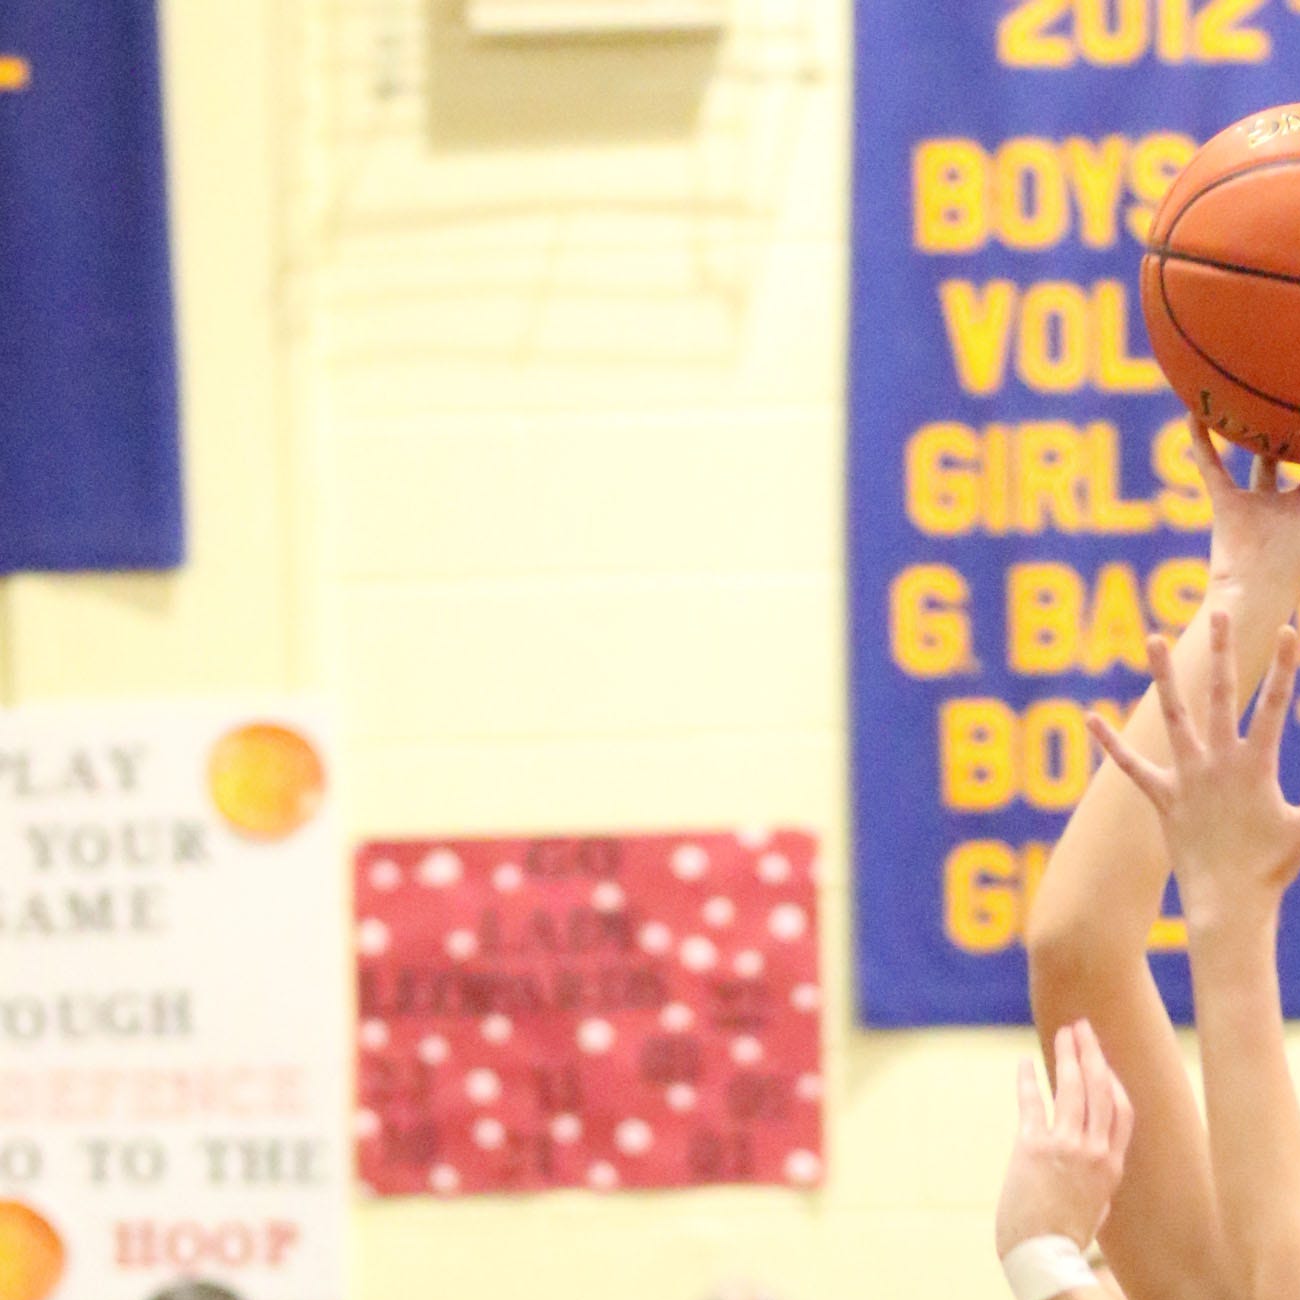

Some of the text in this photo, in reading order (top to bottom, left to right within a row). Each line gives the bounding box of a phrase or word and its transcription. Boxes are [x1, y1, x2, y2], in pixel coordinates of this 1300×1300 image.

[904, 418, 1228, 537] GIRLS
[25, 818, 211, 872] YOUR
[0, 882, 170, 938] AME
[80, 1136, 168, 1186] TO
[202, 1134, 330, 1186] THE
[111, 1217, 301, 1270] HOOP
